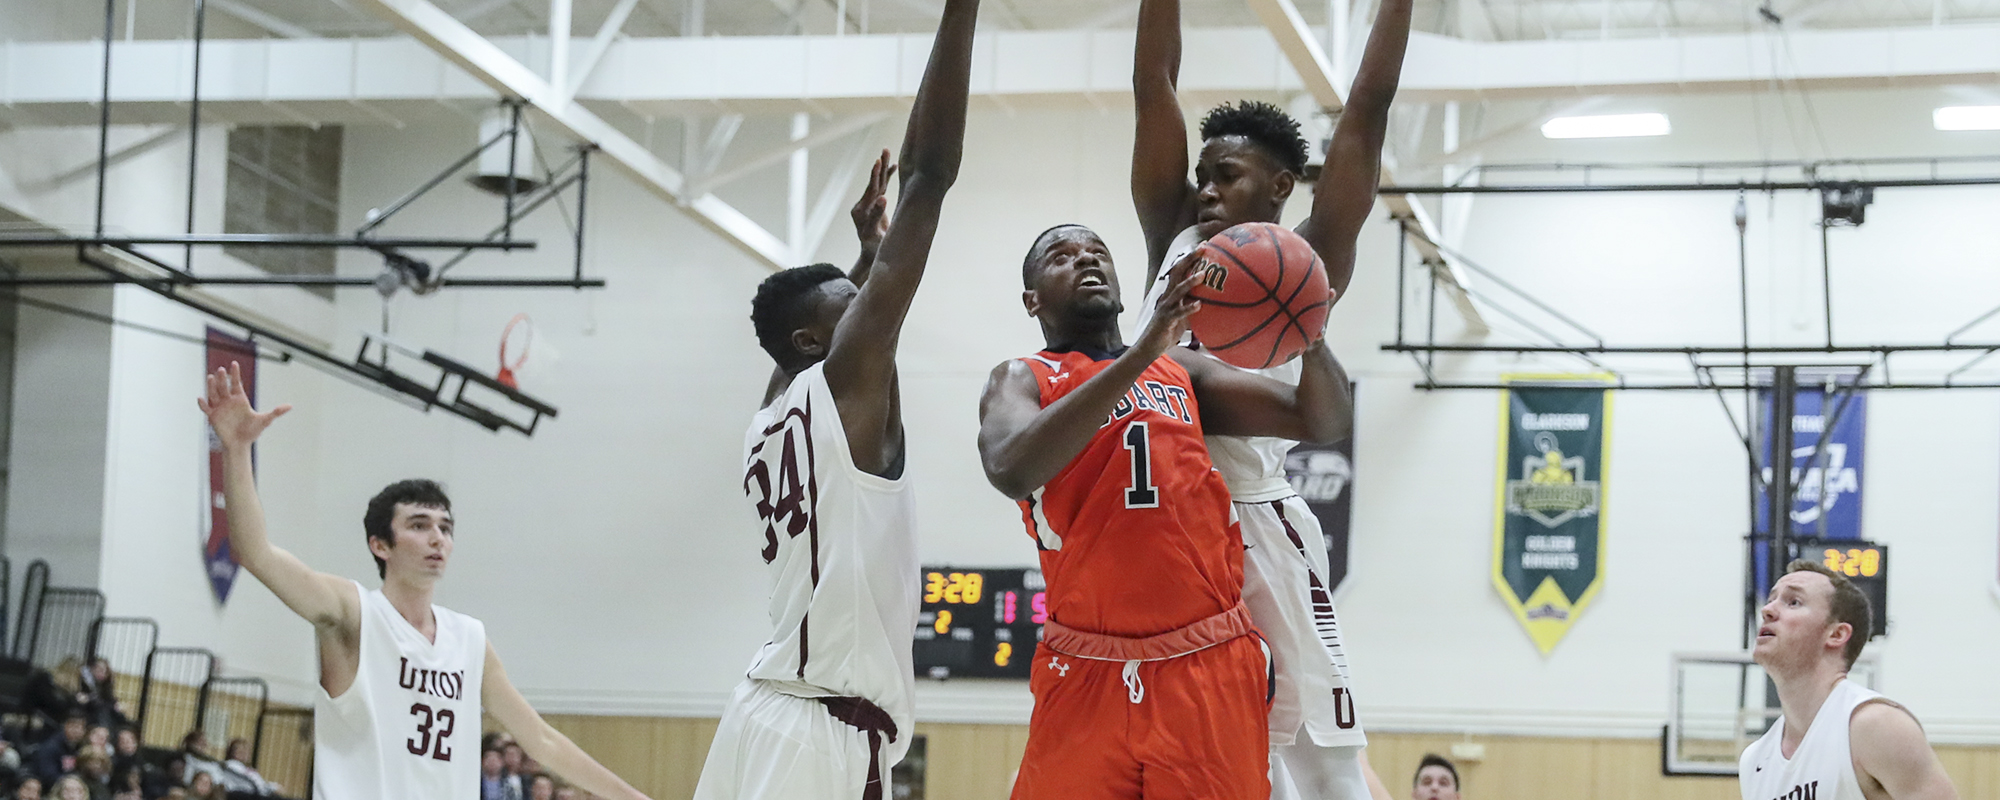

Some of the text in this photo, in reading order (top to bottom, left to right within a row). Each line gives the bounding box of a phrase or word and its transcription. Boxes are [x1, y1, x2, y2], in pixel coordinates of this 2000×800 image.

[1123, 421, 1159, 509] 1
[744, 426, 808, 565] 34
[1286, 471, 1346, 504] ARD
[1823, 548, 1880, 577] 3:28
[924, 572, 983, 604] 3:28
[934, 609, 952, 634] 2
[994, 642, 1012, 667] 2
[1332, 687, 1355, 729] U
[407, 702, 455, 762] 32
